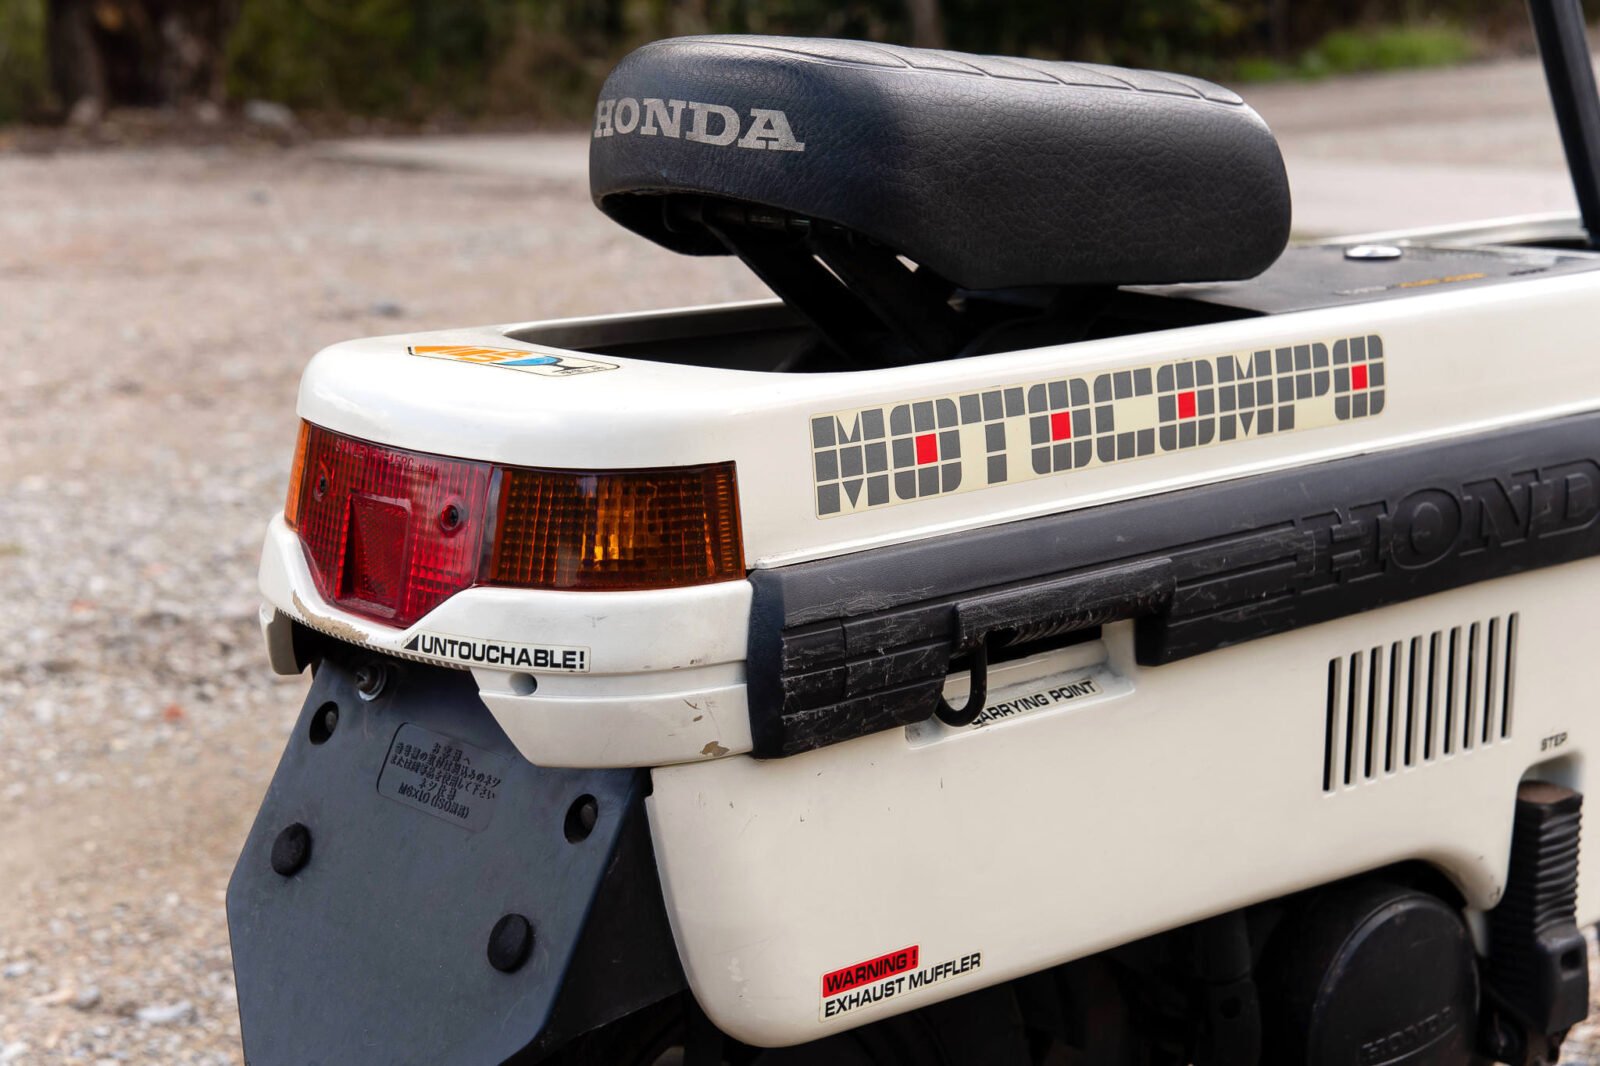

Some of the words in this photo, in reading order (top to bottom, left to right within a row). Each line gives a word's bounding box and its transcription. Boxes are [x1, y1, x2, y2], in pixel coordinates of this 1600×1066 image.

[594, 97, 805, 151] HONDA
[811, 334, 1385, 517] MOTOCOMPO
[421, 634, 585, 670] UNTOUCHABLE!
[1048, 680, 1096, 703] POINT
[824, 977, 905, 1018] EXHAUST
[908, 952, 981, 991] MUFFLER
[826, 955, 907, 992] WARNING
